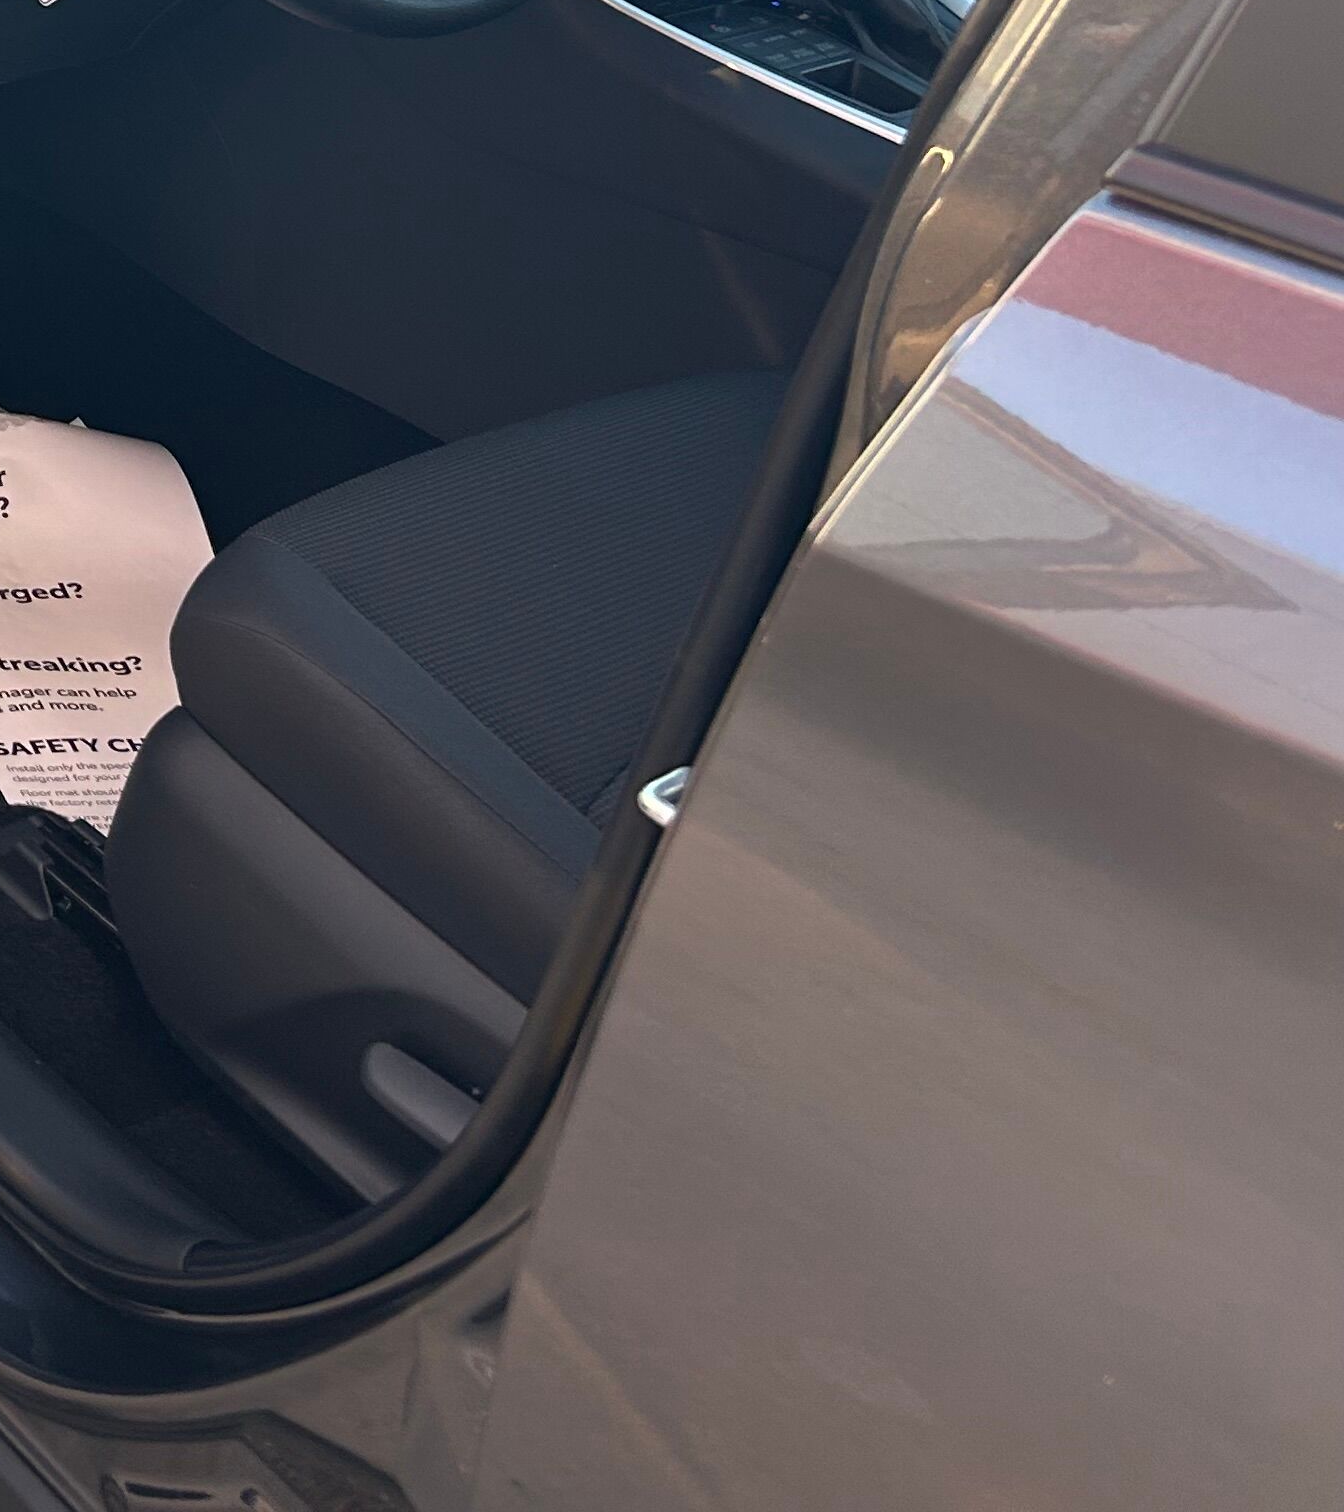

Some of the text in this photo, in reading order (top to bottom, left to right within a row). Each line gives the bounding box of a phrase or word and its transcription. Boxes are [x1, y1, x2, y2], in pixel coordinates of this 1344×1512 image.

[56, 688, 89, 699] can
[92, 686, 138, 701] help
[8, 701, 45, 713] and
[48, 702, 105, 713] more.
[6, 763, 45, 773] Install
[47, 763, 74, 773] only
[75, 761, 97, 770] the
[12, 773, 121, 784] designed for your
[19, 788, 52, 797] Floor
[55, 789, 80, 797] mat
[49, 799, 93, 807] factory
